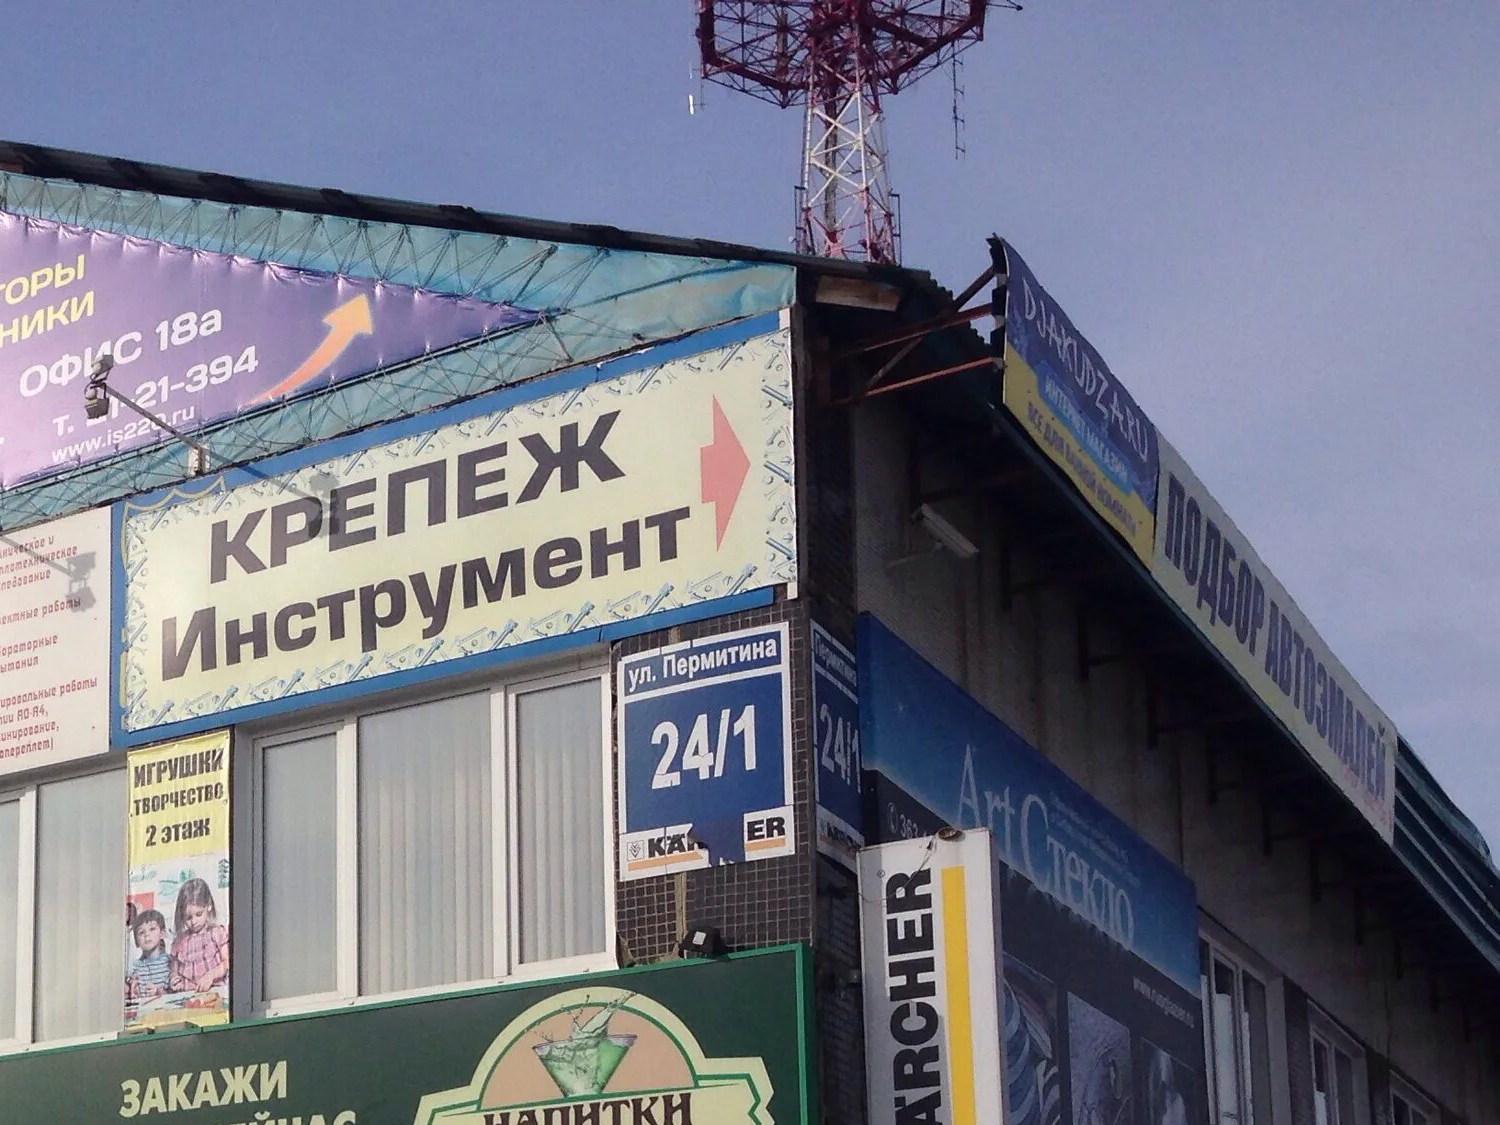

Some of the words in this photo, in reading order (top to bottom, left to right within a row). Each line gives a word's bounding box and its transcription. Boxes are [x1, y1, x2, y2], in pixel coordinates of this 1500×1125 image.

[156, 309, 222, 351] 18а
[86, 345, 259, 427] 1-21-394
[209, 409, 627, 584] КРЕПЕЖ
[1164, 470, 1265, 657] ПОДБОР
[41, 598, 82, 617] работы
[161, 506, 691, 682] Инструмент
[59, 677, 98, 696] работы
[628, 668, 657, 692] ул.
[663, 638, 778, 679] Пермитина
[1264, 601, 1387, 801] АВТОЭМАЛЕЙ
[133, 748, 224, 789] ИГРУШКИ
[651, 705, 757, 789] 24/1
[820, 703, 862, 793] 24/1
[133, 782, 225, 817] ТВОРЧЕСТВО
[145, 825, 157, 847] 2
[160, 820, 211, 846] этаж
[117, 1060, 288, 1117] ЗАКАЖИ
